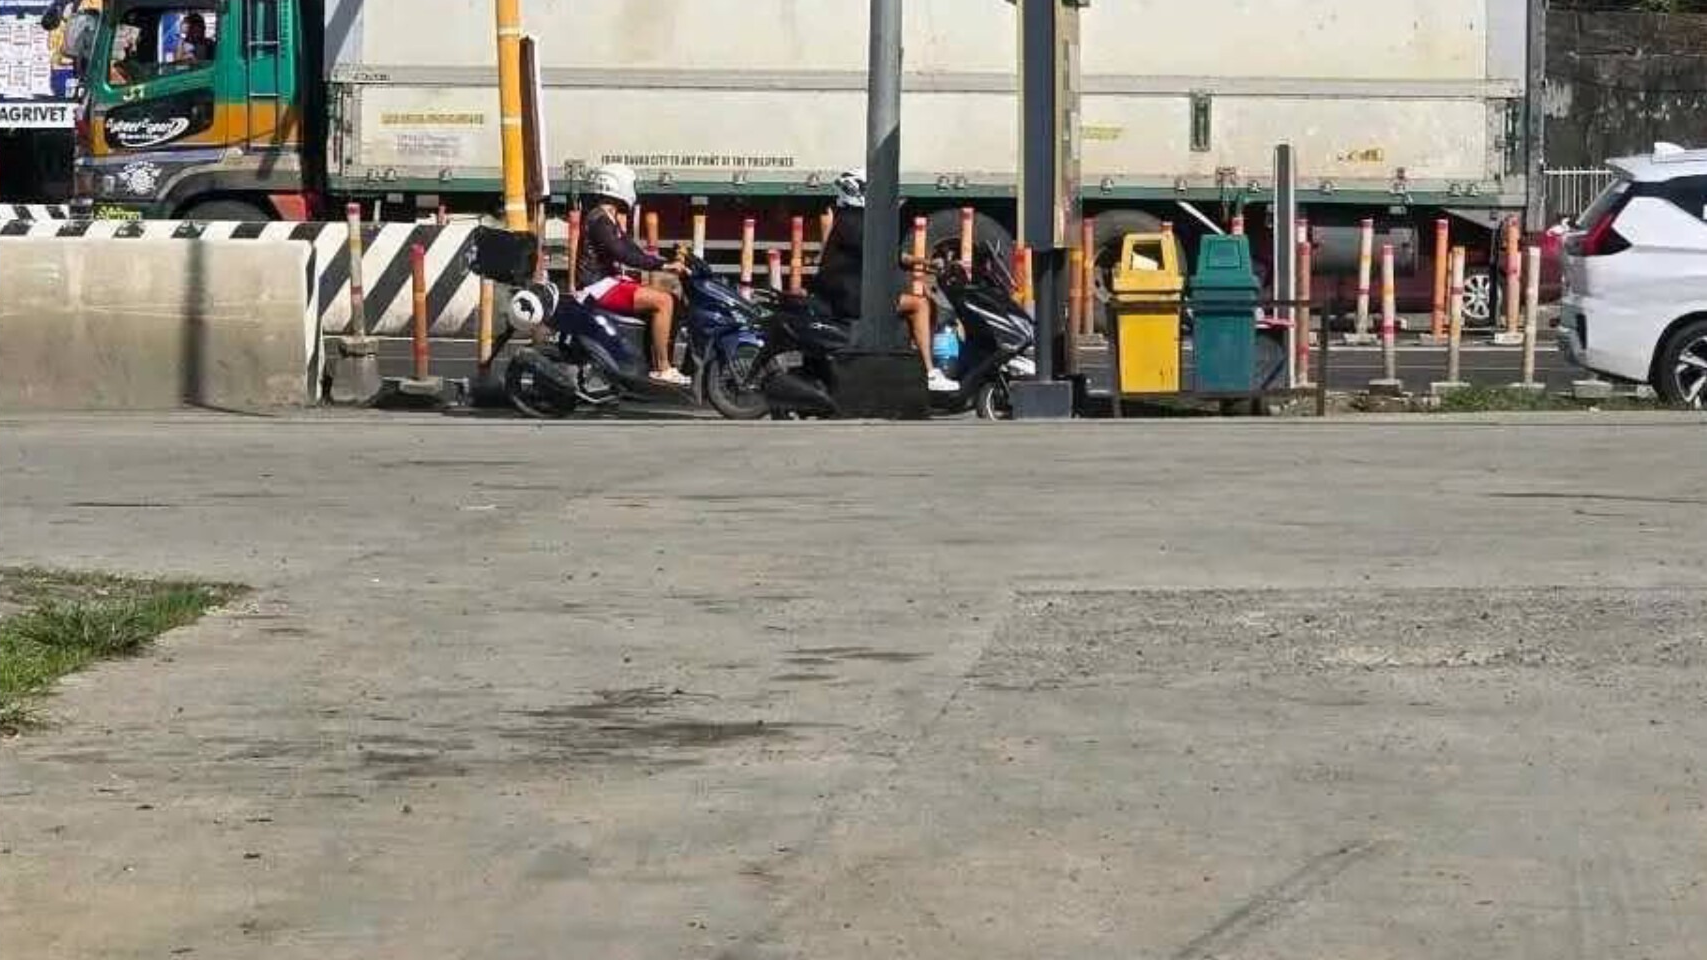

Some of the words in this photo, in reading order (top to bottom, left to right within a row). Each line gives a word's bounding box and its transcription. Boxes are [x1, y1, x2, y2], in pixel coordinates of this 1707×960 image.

[0, 106, 68, 122] AGRIVET
[650, 154, 668, 166] CITY
[669, 154, 679, 166] TO
[681, 154, 696, 166] ANY
[697, 154, 719, 166] POINT
[732, 155, 745, 166] THE
